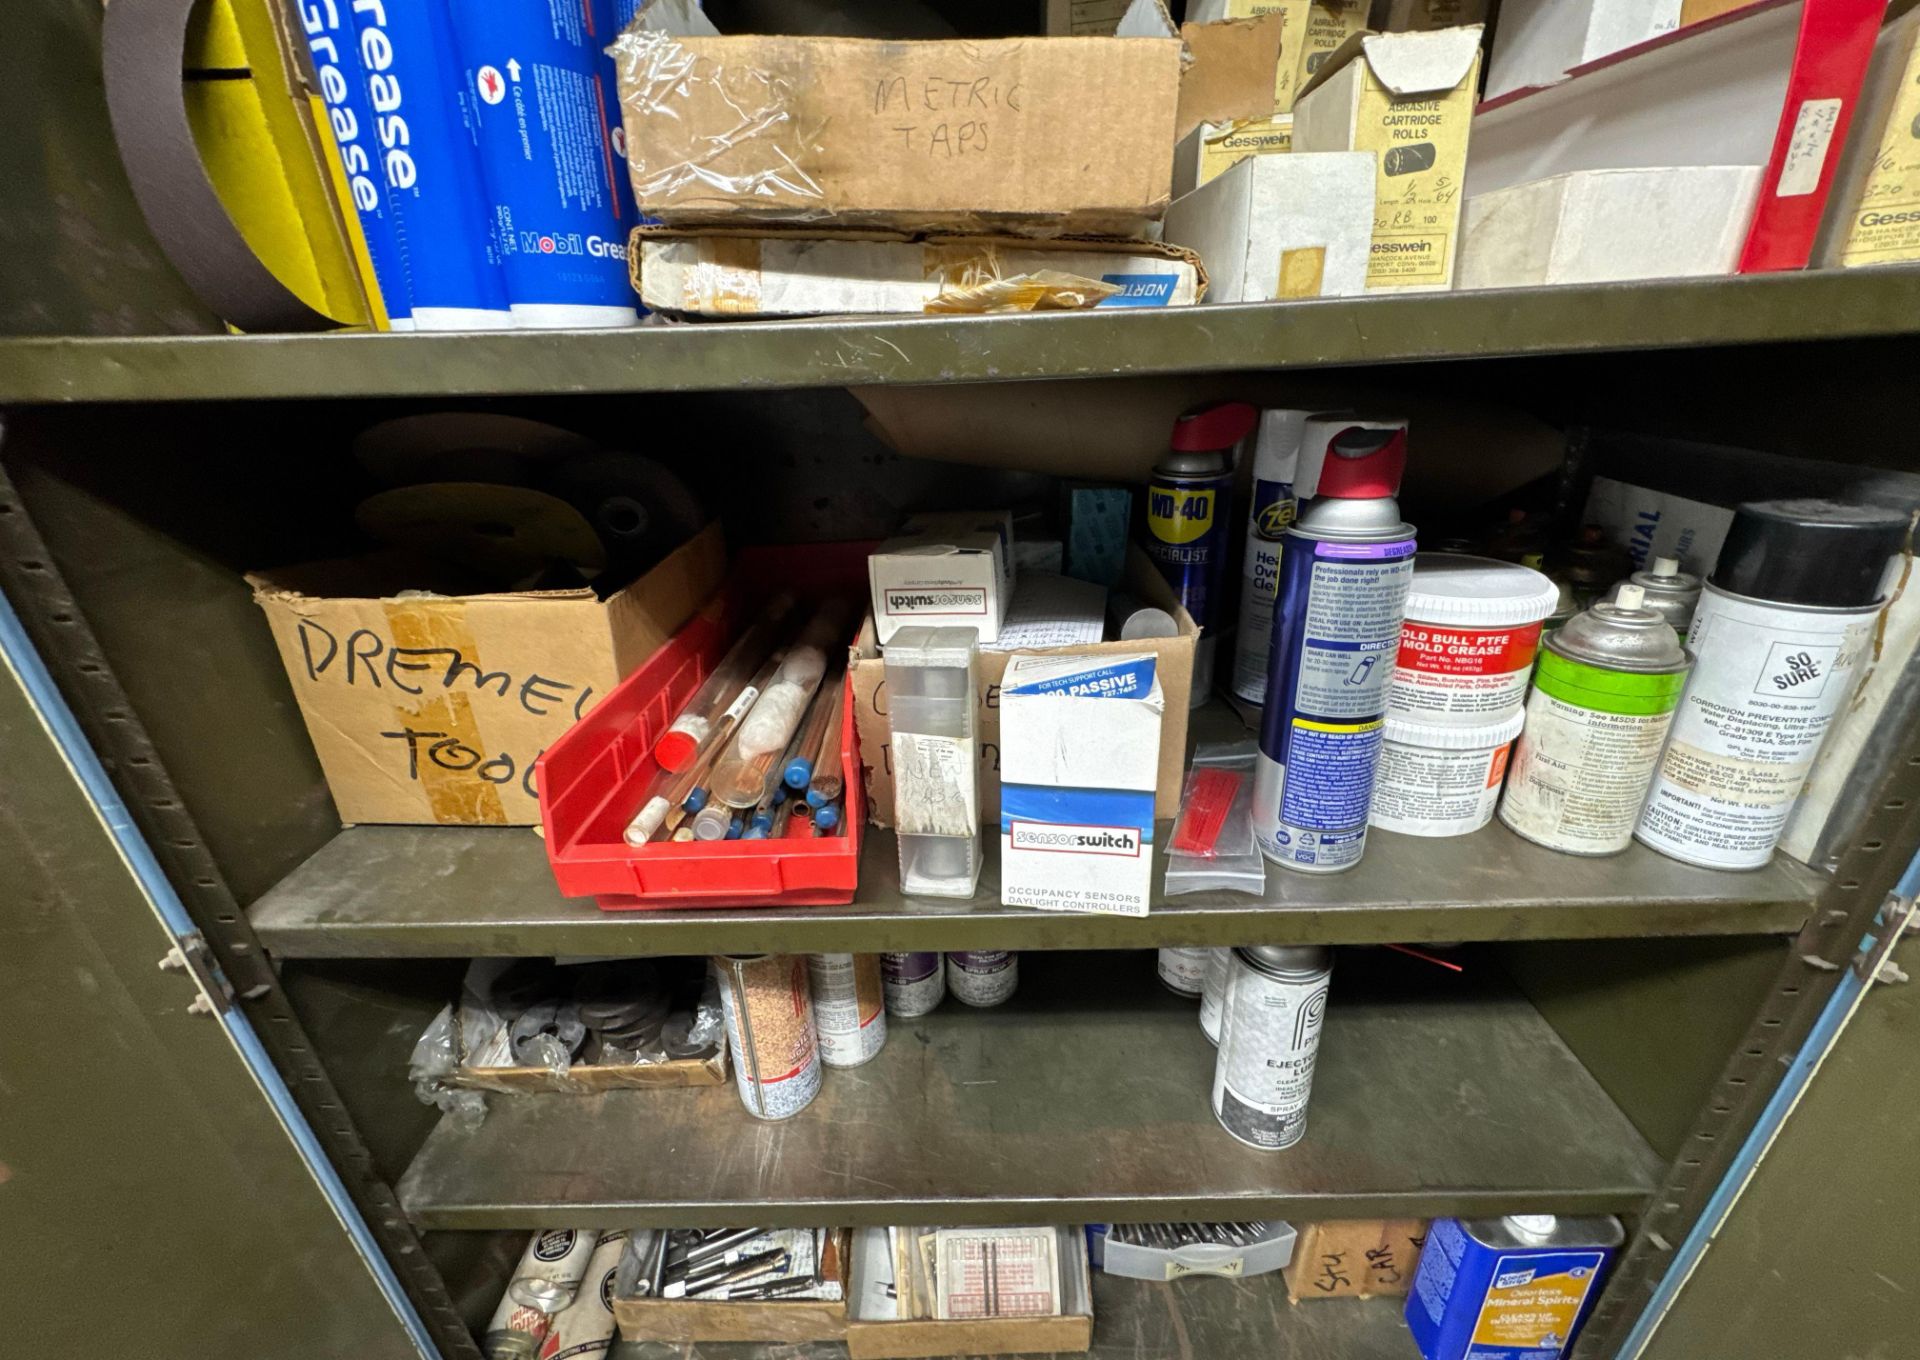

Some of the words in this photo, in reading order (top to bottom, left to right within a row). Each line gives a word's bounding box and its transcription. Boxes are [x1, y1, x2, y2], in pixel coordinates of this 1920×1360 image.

[1308, 28, 1346, 38] CARTRIDGE
[1314, 39, 1336, 47] ROLLS
[875, 76, 1024, 115] METRIC
[1388, 101, 1440, 112] ABRASIVE
[1383, 115, 1441, 126] CARTRIDGE
[892, 121, 988, 157] TAPS
[1222, 132, 1290, 148] Gesswein
[1393, 128, 1428, 139] ROLLS
[518, 129, 532, 160] premier
[520, 232, 583, 255] Mobil
[1372, 241, 1431, 254] esswein
[1152, 492, 1209, 520] WD-40
[1315, 565, 1364, 576] Professionals
[1366, 568, 1379, 577] rely
[890, 594, 981, 610] sensorswitch
[1690, 618, 1703, 643] WELL
[1403, 640, 1443, 653] MOLD
[1447, 646, 1503, 655] GREASE
[1432, 634, 1469, 645] BULL
[1476, 635, 1510, 645] PTFE
[1420, 654, 1437, 662] Part
[1785, 652, 1811, 670] SO
[1038, 682, 1051, 690] FOR
[1051, 679, 1068, 687] TECH
[1068, 673, 1096, 684] SUPPORT
[1773, 665, 1821, 690] SURE
[1551, 700, 1585, 717] Warning
[1589, 711, 1607, 720] See
[1610, 715, 1635, 724] MSDS
[1691, 695, 1745, 717] CORROSION
[1748, 711, 1808, 724] PREVENTIVE
[1700, 706, 1724, 720] Water
[1727, 714, 1780, 730] Displacing,
[1588, 719, 1643, 731] information
[1704, 718, 1763, 737] MIL-C-81309
[1775, 732, 1796, 742] Type
[1719, 729, 1747, 741] Grade
[1535, 753, 1551, 765] First
[1552, 760, 1567, 770] Aid
[1667, 758, 1687, 771] FLASH
[1687, 766, 1710, 777] POINT
[1699, 763, 1720, 776] SALES
[1716, 764, 1737, 773] TYPE
[1660, 789, 1701, 810] IMPORTANT!
[1711, 796, 1729, 805] Net
[1730, 799, 1741, 807] Wt.
[1647, 804, 1683, 827] CAUTION:
[1657, 802, 1691, 820] CONTAINS
[1693, 816, 1704, 824] NO
[1705, 819, 1733, 830] OZONE
[1016, 831, 1134, 849] sensorswitch
[1660, 824, 1692, 842] CAUTIONS
[1694, 836, 1710, 846] AND
[1712, 842, 1738, 851] HEALTH
[1008, 886, 1080, 899] OCCUPANCY
[1084, 891, 1141, 904] SENSORS
[1008, 896, 1059, 908] DAYLIGHT
[1062, 900, 1141, 914] CONTROLLERS
[1270, 1103, 1299, 1113] SPRAY
[1487, 1297, 1534, 1307] Mineral
[1537, 1295, 1580, 1306] Spirits
[1511, 1288, 1562, 1298] Odorless
